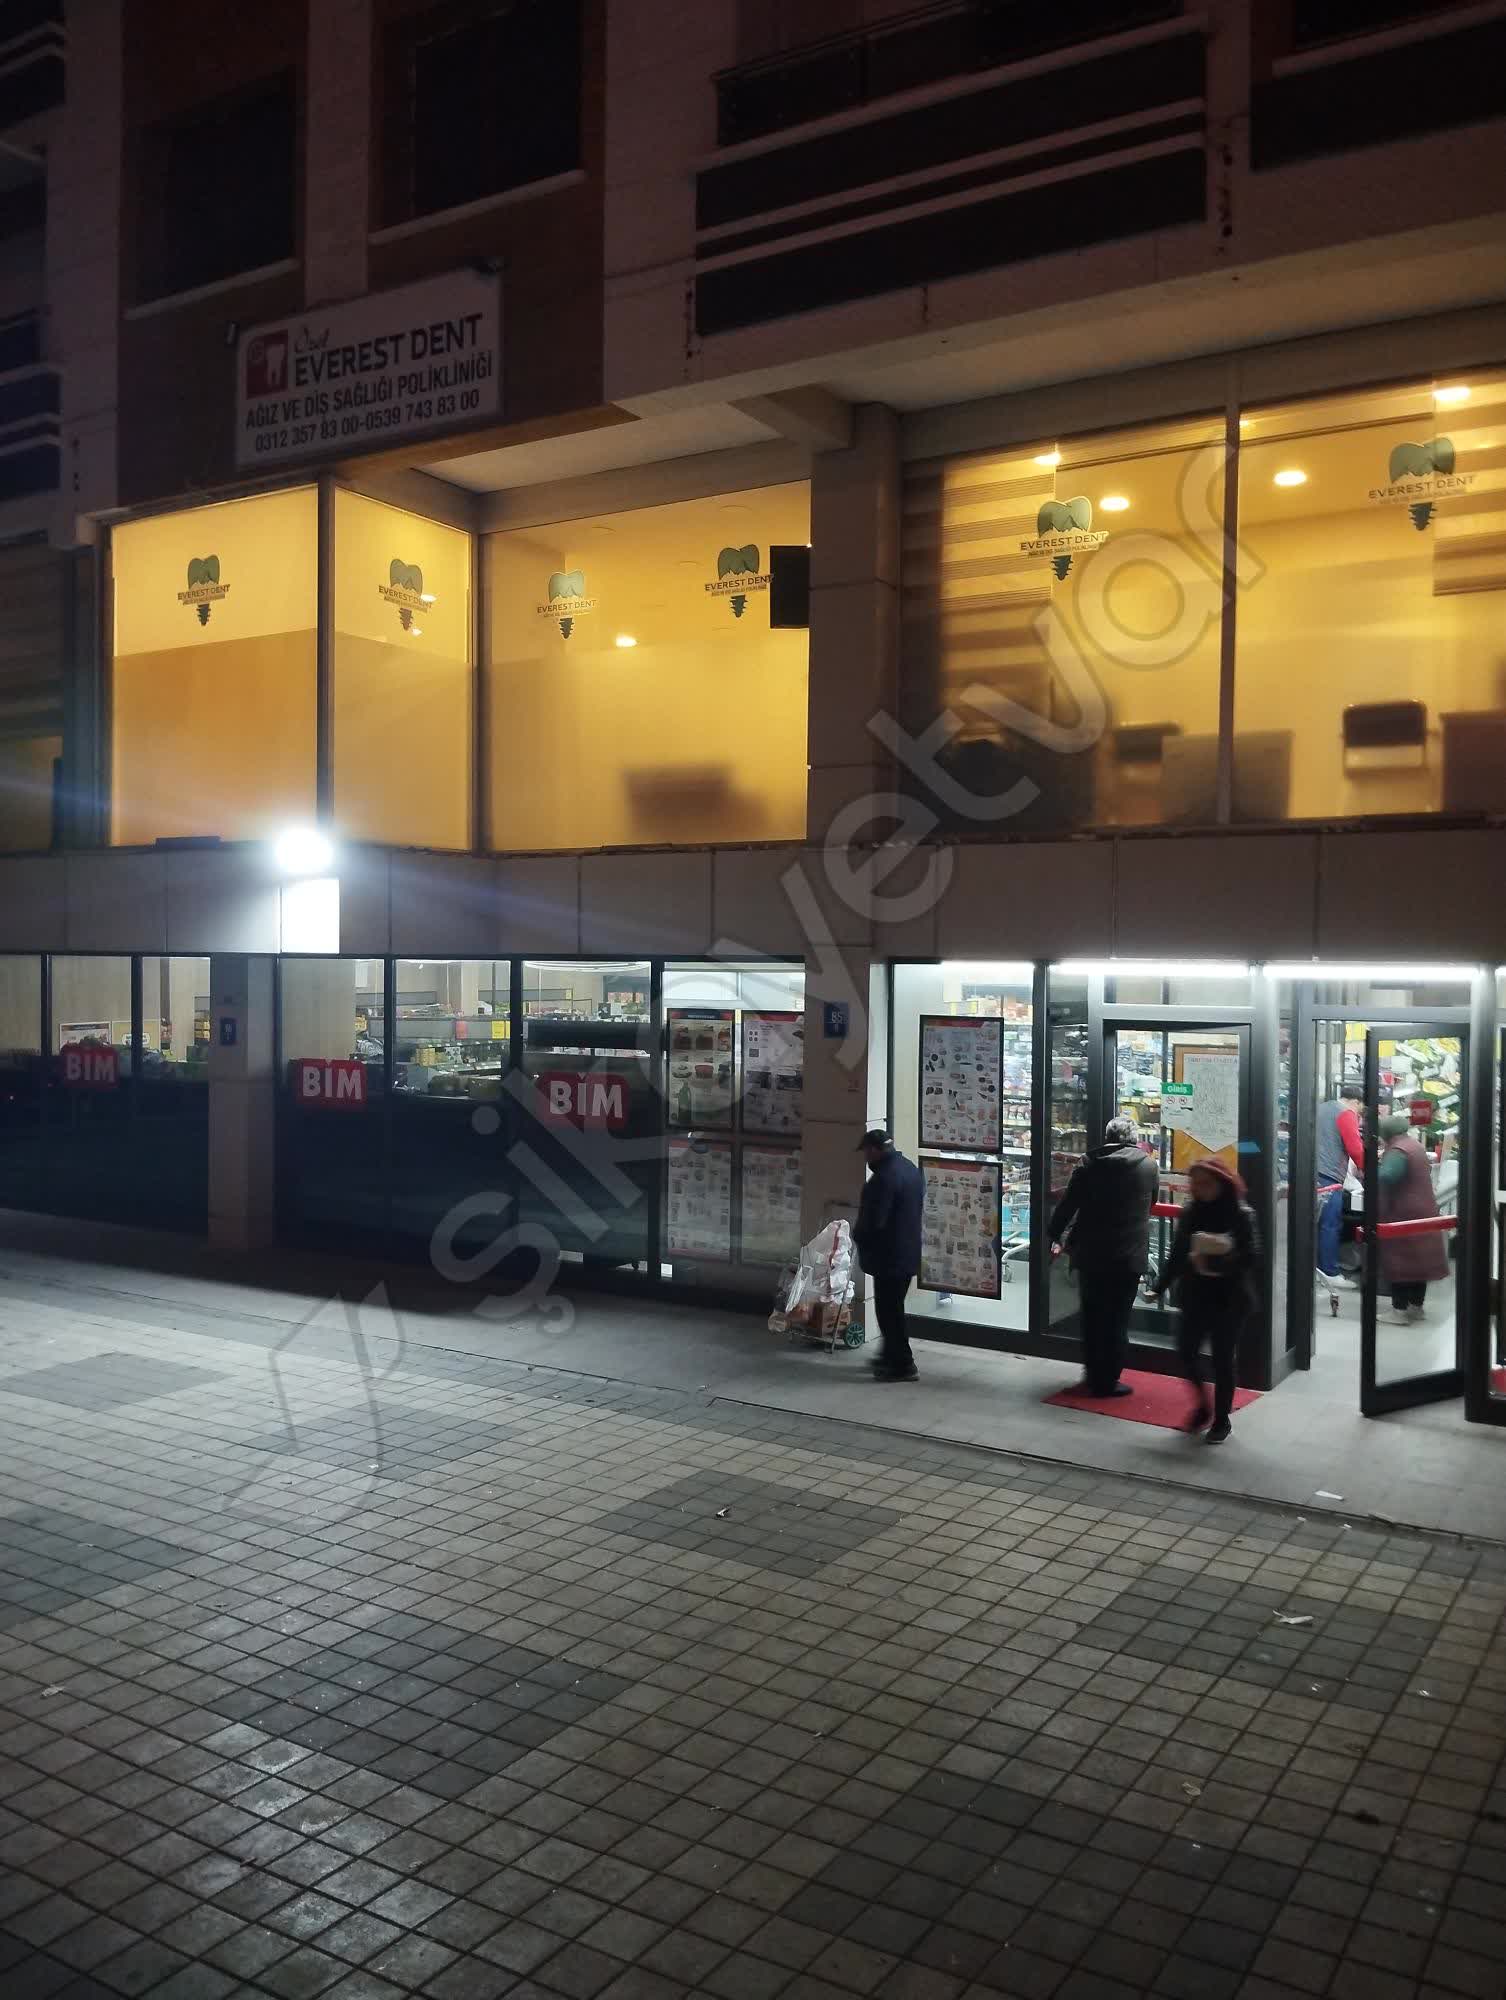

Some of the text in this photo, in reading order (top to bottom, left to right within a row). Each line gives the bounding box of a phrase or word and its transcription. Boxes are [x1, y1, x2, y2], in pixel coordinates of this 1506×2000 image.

[295, 313, 483, 387] EVEREST DENT
[246, 402, 278, 429] AĞIZ
[282, 399, 301, 422] VE
[333, 378, 393, 410] SAĞLIĞI
[398, 350, 492, 396] POLİKLİNİĞİ
[255, 428, 287, 451] 0312
[292, 423, 315, 444] 357
[320, 418, 337, 439] 83
[406, 400, 433, 422] 743
[437, 394, 455, 416] 83
[460, 389, 480, 413] 00
[1368, 481, 1433, 498] EVEREST
[1436, 475, 1475, 489] DENT
[1020, 532, 1106, 550] EVEREST DENT
[178, 588, 209, 600] EVEREST
[210, 583, 231, 594] DENT
[378, 585, 413, 603] EVEREST
[705, 578, 747, 591] EVEREST
[537, 602, 574, 613] EVEREST
[574, 599, 597, 608] DENT
[302, 1057, 363, 1101] BİM
[549, 1071, 623, 1119] BİM
